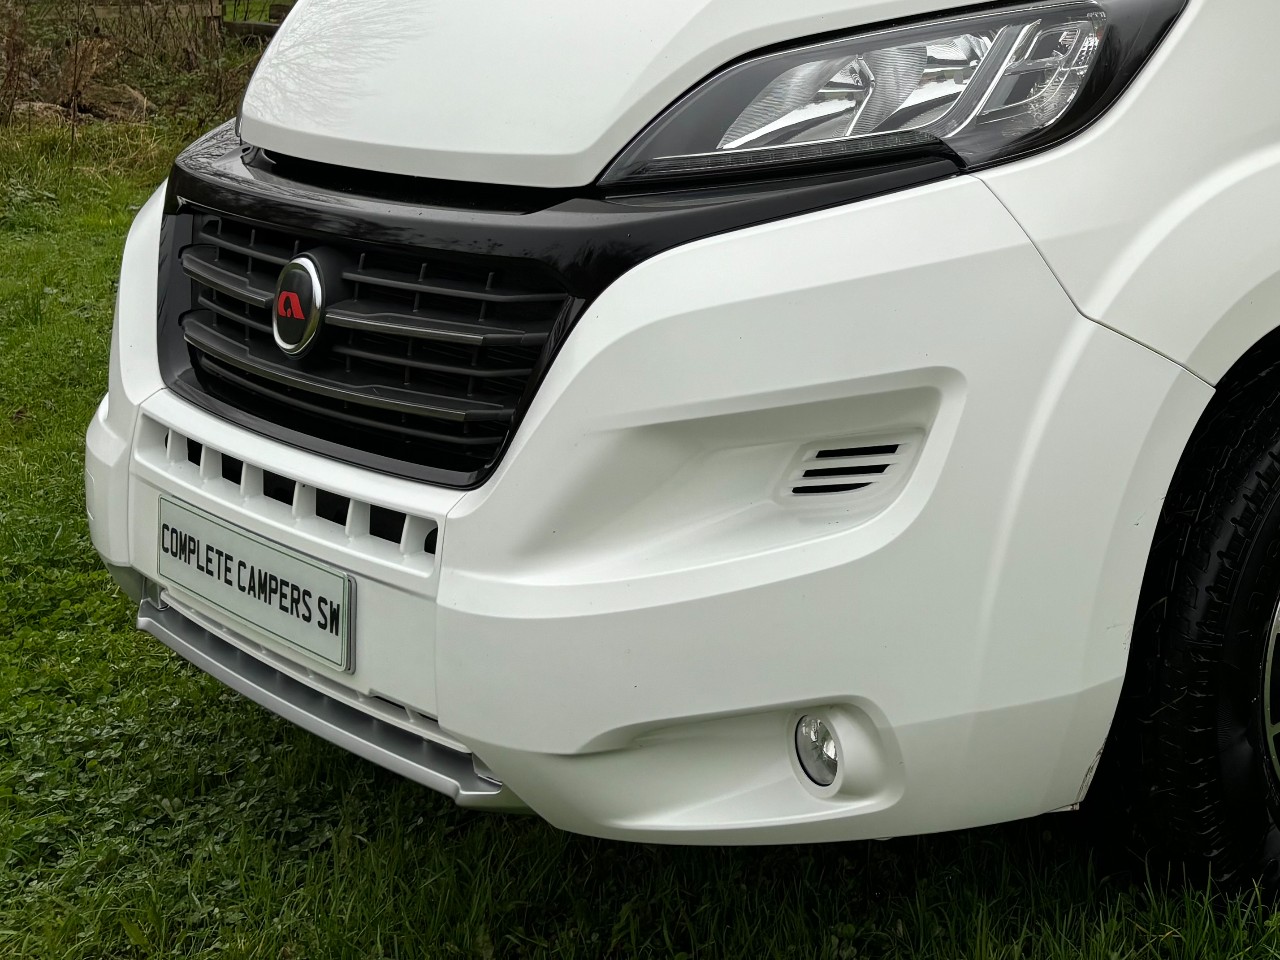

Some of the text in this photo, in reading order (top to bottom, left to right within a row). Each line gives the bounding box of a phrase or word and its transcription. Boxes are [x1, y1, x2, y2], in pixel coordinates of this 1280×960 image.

[161, 523, 341, 637] COMPLETE CAMPERS SW
